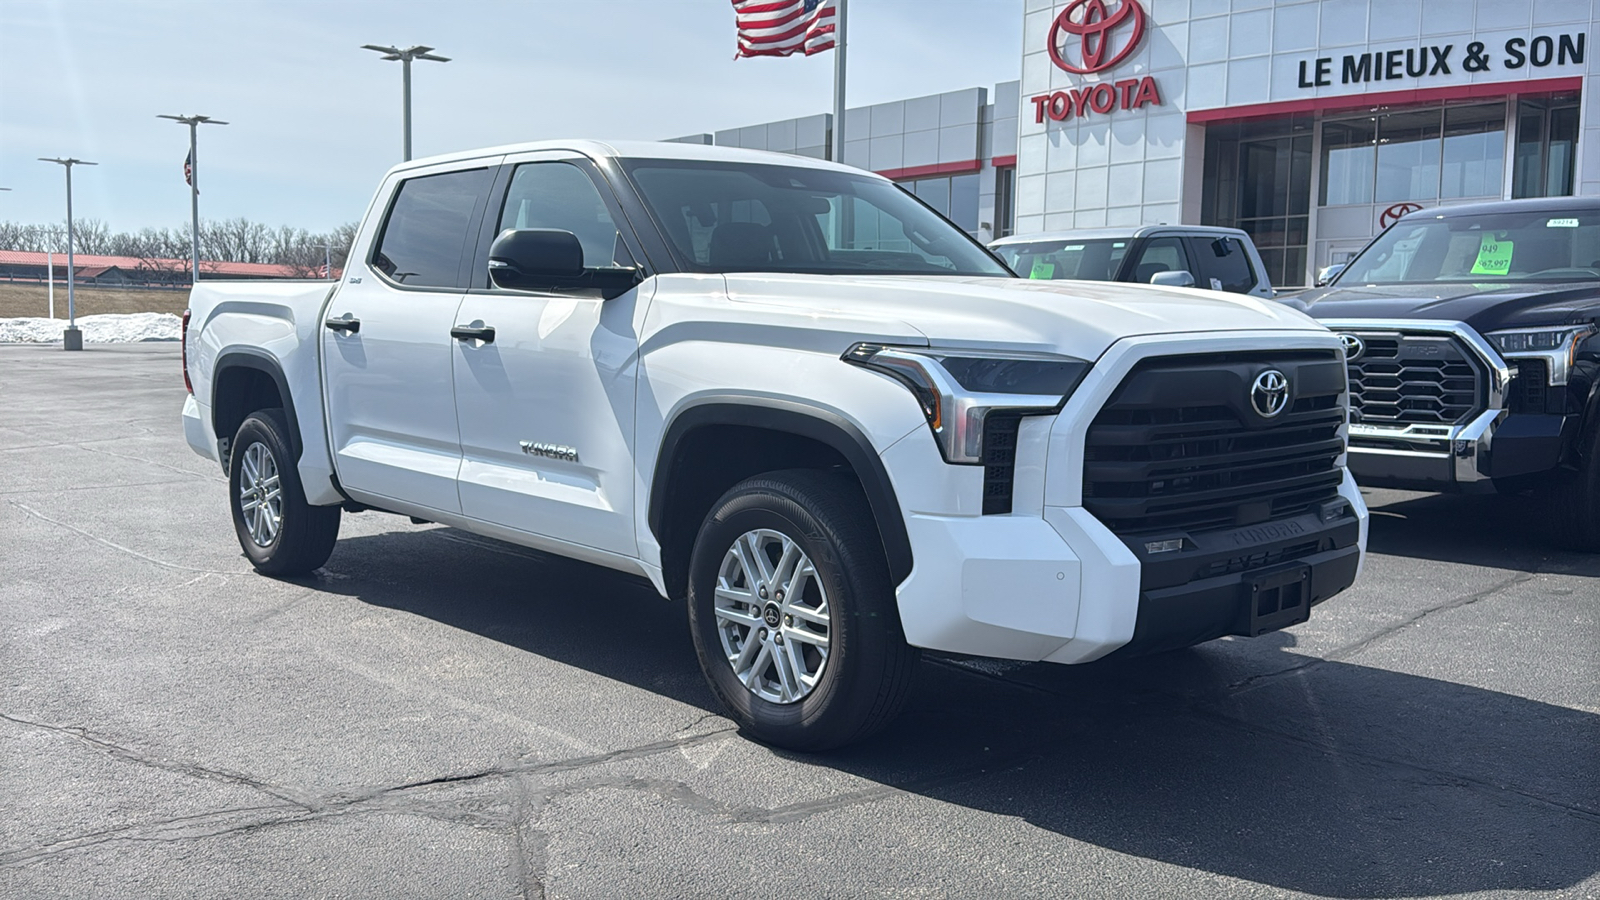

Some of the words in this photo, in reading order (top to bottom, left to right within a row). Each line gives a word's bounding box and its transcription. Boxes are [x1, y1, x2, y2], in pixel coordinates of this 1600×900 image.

[1298, 57, 1332, 88] LE
[1341, 44, 1453, 84] MIEUX
[1462, 41, 1490, 72] &
[1504, 32, 1586, 68] SON
[1031, 76, 1160, 123] TOYOTA
[519, 440, 579, 463] TUNDRA
[1232, 521, 1305, 544] TUNDRA
